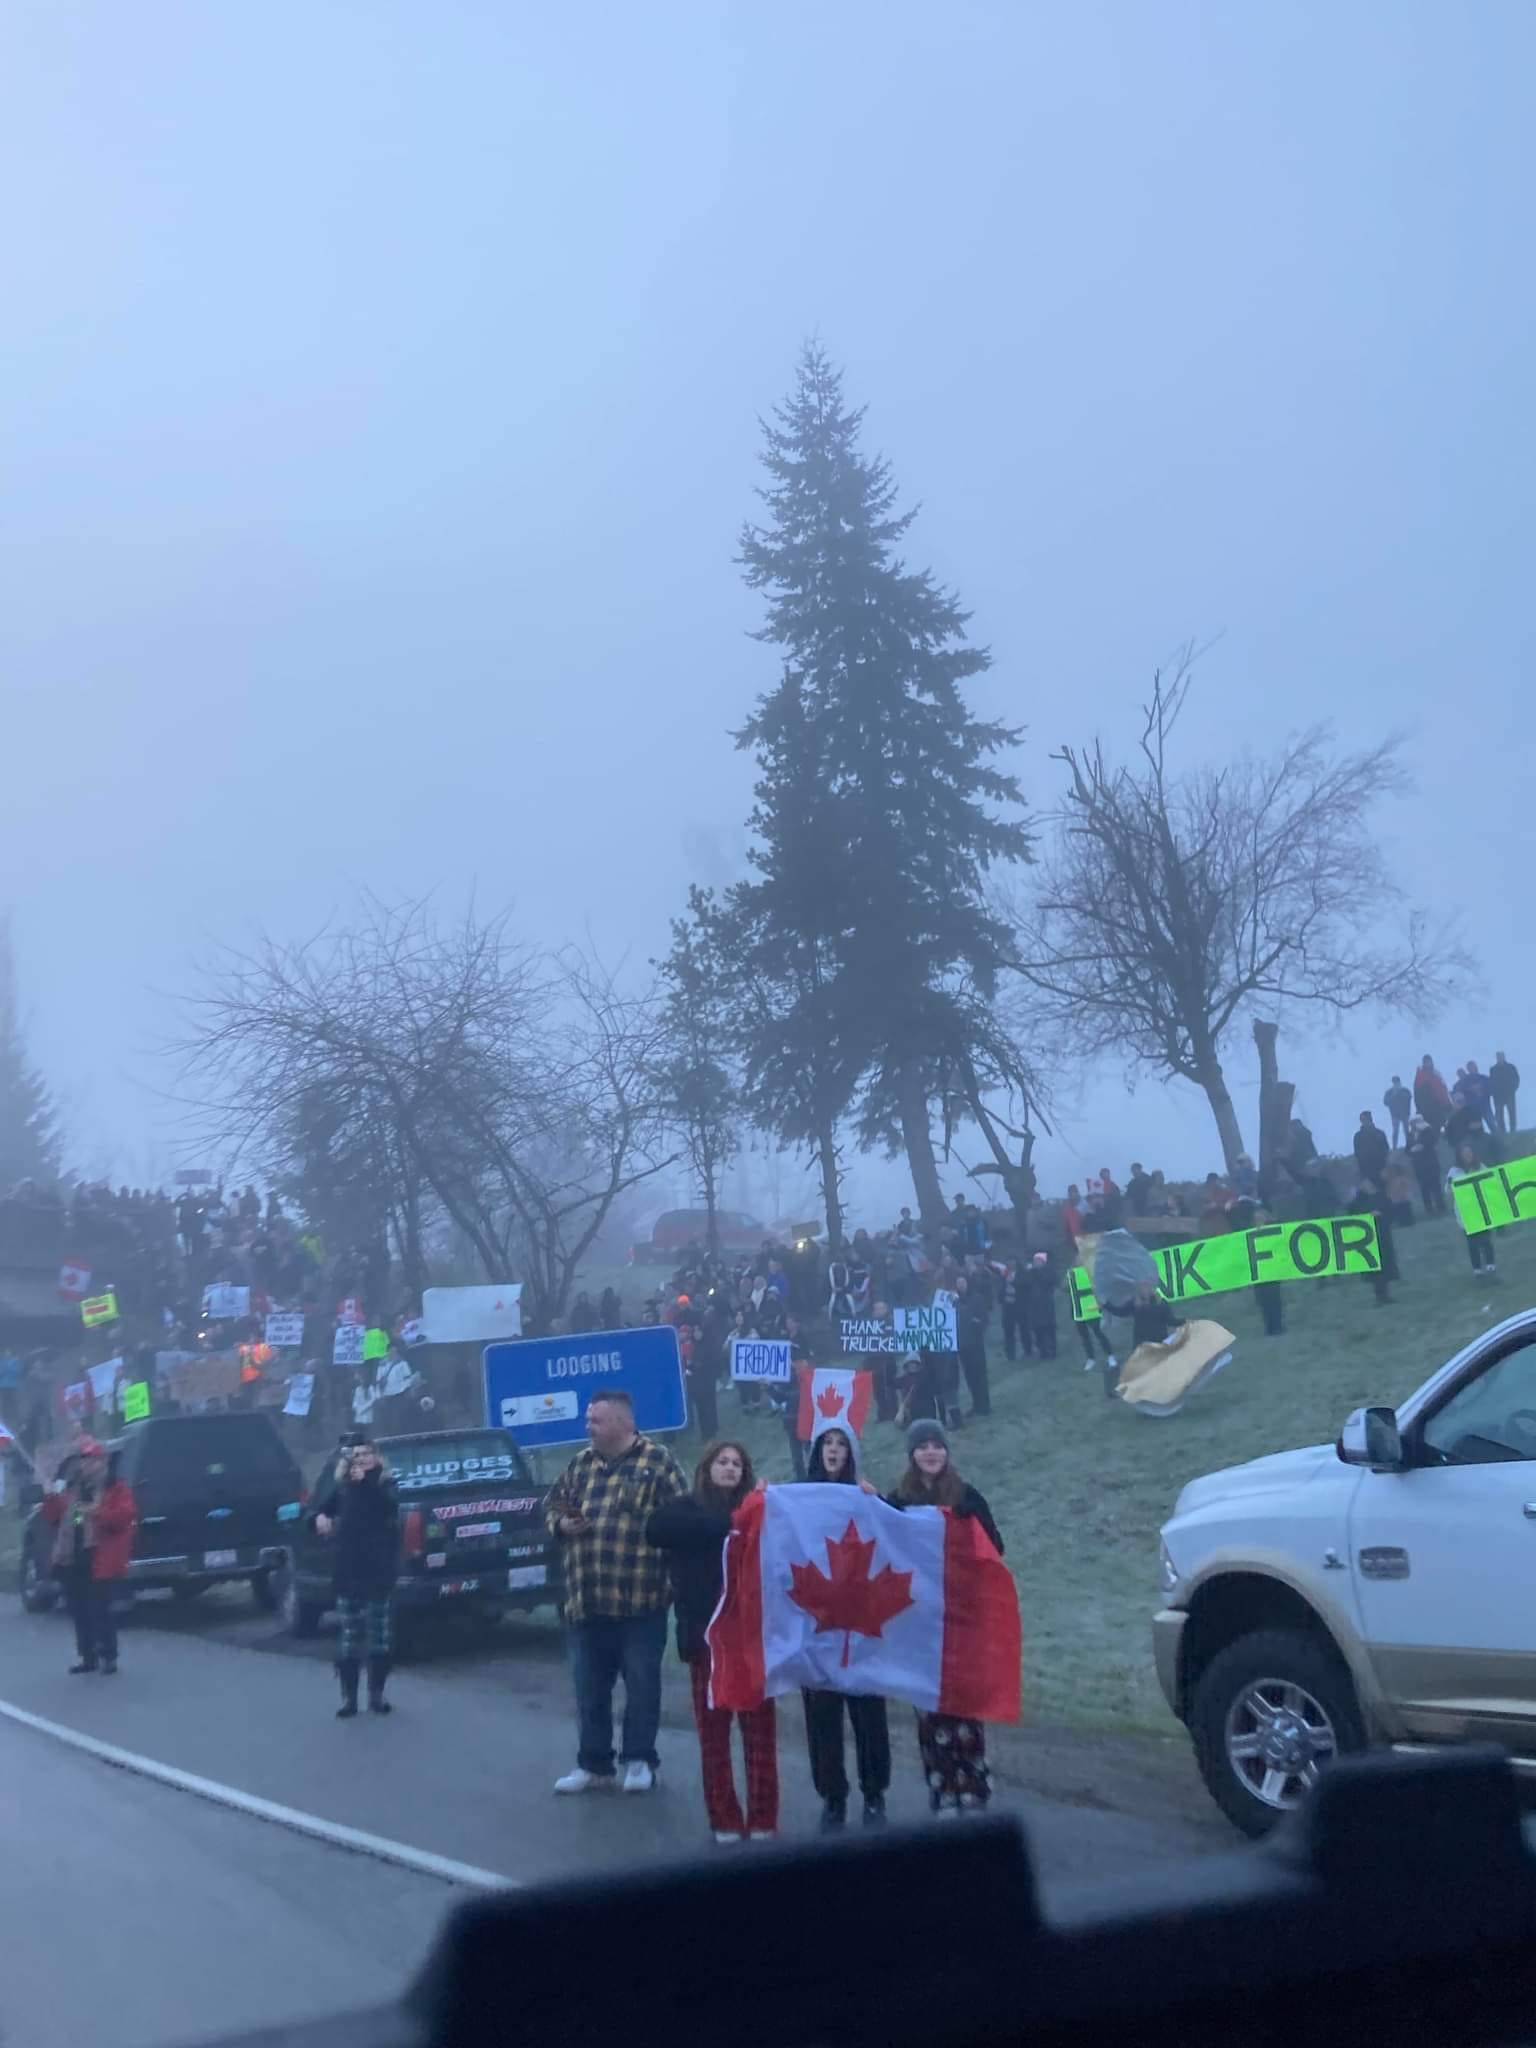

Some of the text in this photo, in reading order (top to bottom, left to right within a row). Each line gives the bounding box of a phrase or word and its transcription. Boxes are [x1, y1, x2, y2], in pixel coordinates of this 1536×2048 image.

[1246, 1219, 1378, 1282] FOR
[904, 1306, 946, 1329] END
[546, 1351, 624, 1379] LODGING
[407, 1455, 513, 1477] JUDGES
